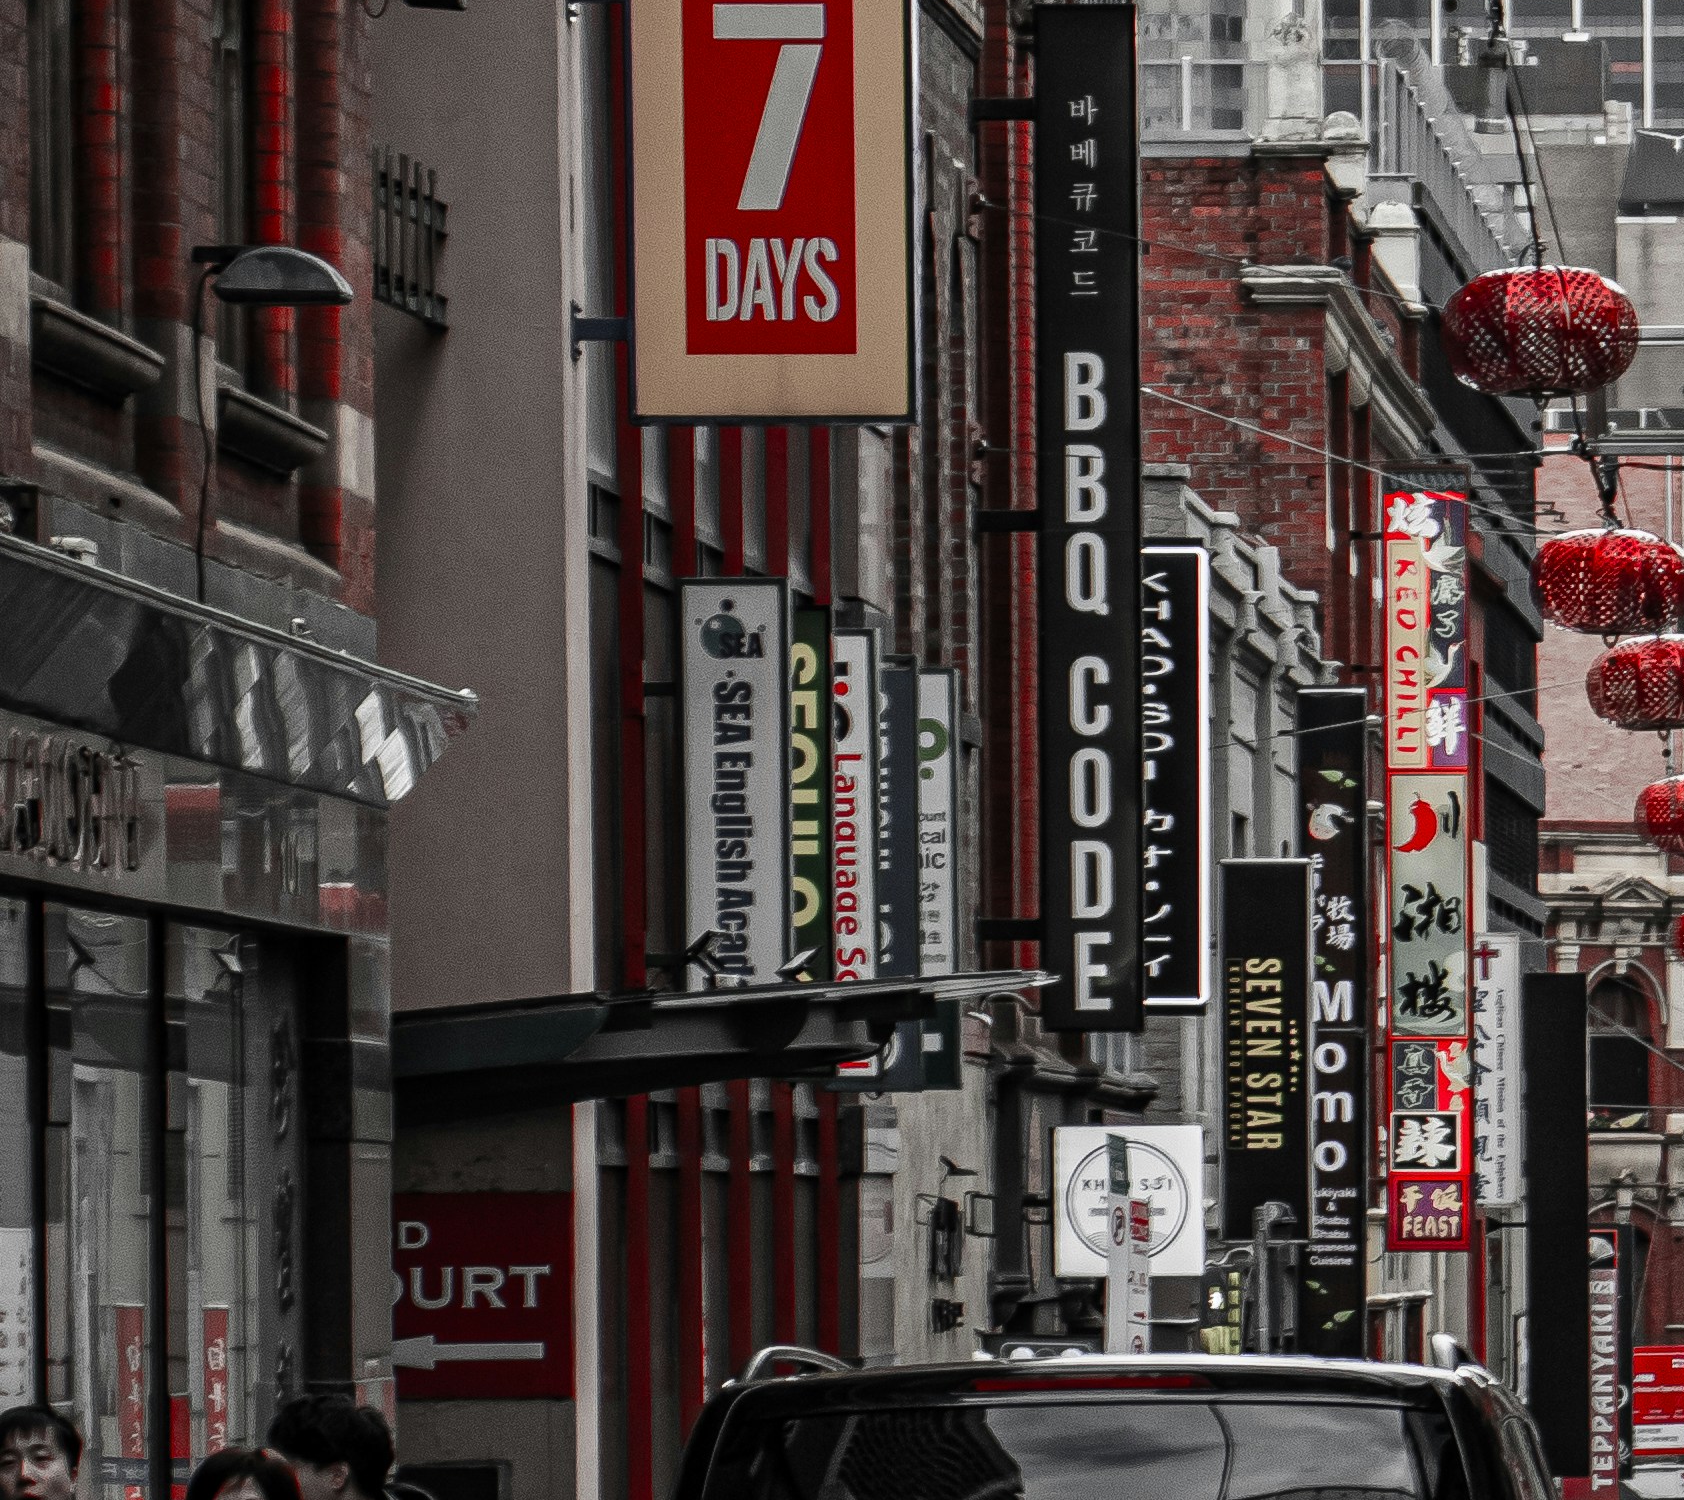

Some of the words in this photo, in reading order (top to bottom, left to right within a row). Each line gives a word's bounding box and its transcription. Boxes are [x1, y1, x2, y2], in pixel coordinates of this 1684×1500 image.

[712, 3, 826, 211] 7
[1067, 94, 1100, 296] 바베큐코드
[705, 238, 840, 323] DAYS
[1062, 351, 1110, 617] BBQ
[720, 632, 764, 659] SEA
[1395, 558, 1419, 631] RED
[712, 680, 752, 746] SEA
[1395, 645, 1420, 754] CHILLI
[708, 751, 755, 884] English
[1069, 656, 1114, 1012] CODE
[1245, 957, 1283, 1057] SEVEN
[1245, 1072, 1283, 1149] STAR
[1311, 979, 1354, 1173] Momo
[1397, 1115, 1458, 1167] 辣
[1401, 1214, 1460, 1241] FEAST
[1591, 1303, 1615, 1492] TEPPANYAKI
